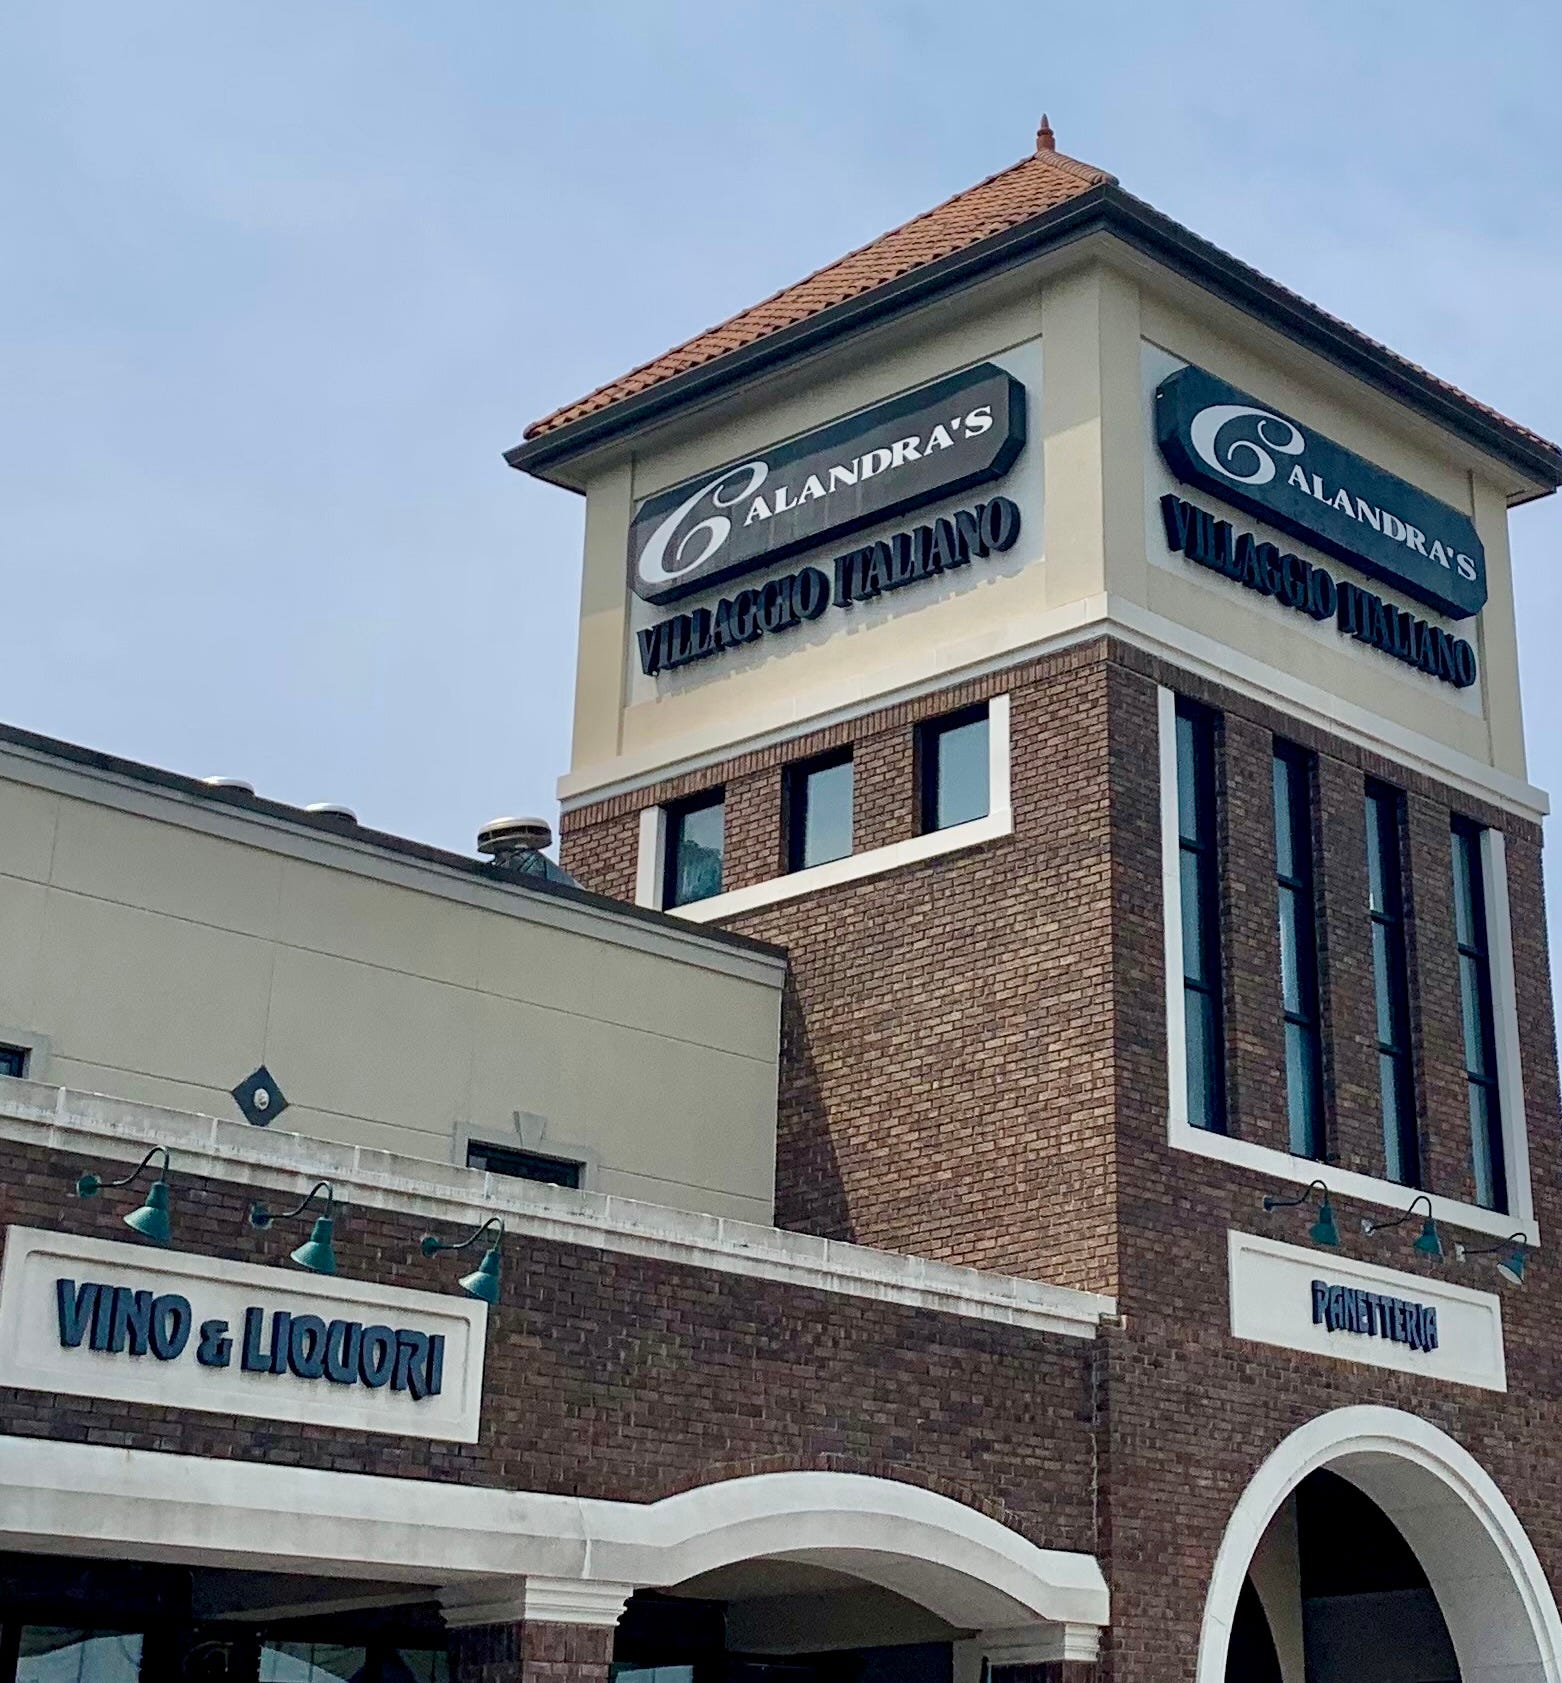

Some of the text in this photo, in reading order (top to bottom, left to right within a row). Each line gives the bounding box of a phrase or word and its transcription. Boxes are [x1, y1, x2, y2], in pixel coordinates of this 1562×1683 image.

[638, 405, 995, 584] CALANDRA'S
[1190, 404, 1478, 582] CALANDRA'S
[637, 496, 1021, 678] VILLAGGIO ITALIANO
[1160, 493, 1478, 688] VILLAGGIO ITALIANO
[56, 1278, 446, 1401] VINO & LIQUORI
[1311, 1279, 1439, 1353] PANETTERIA
